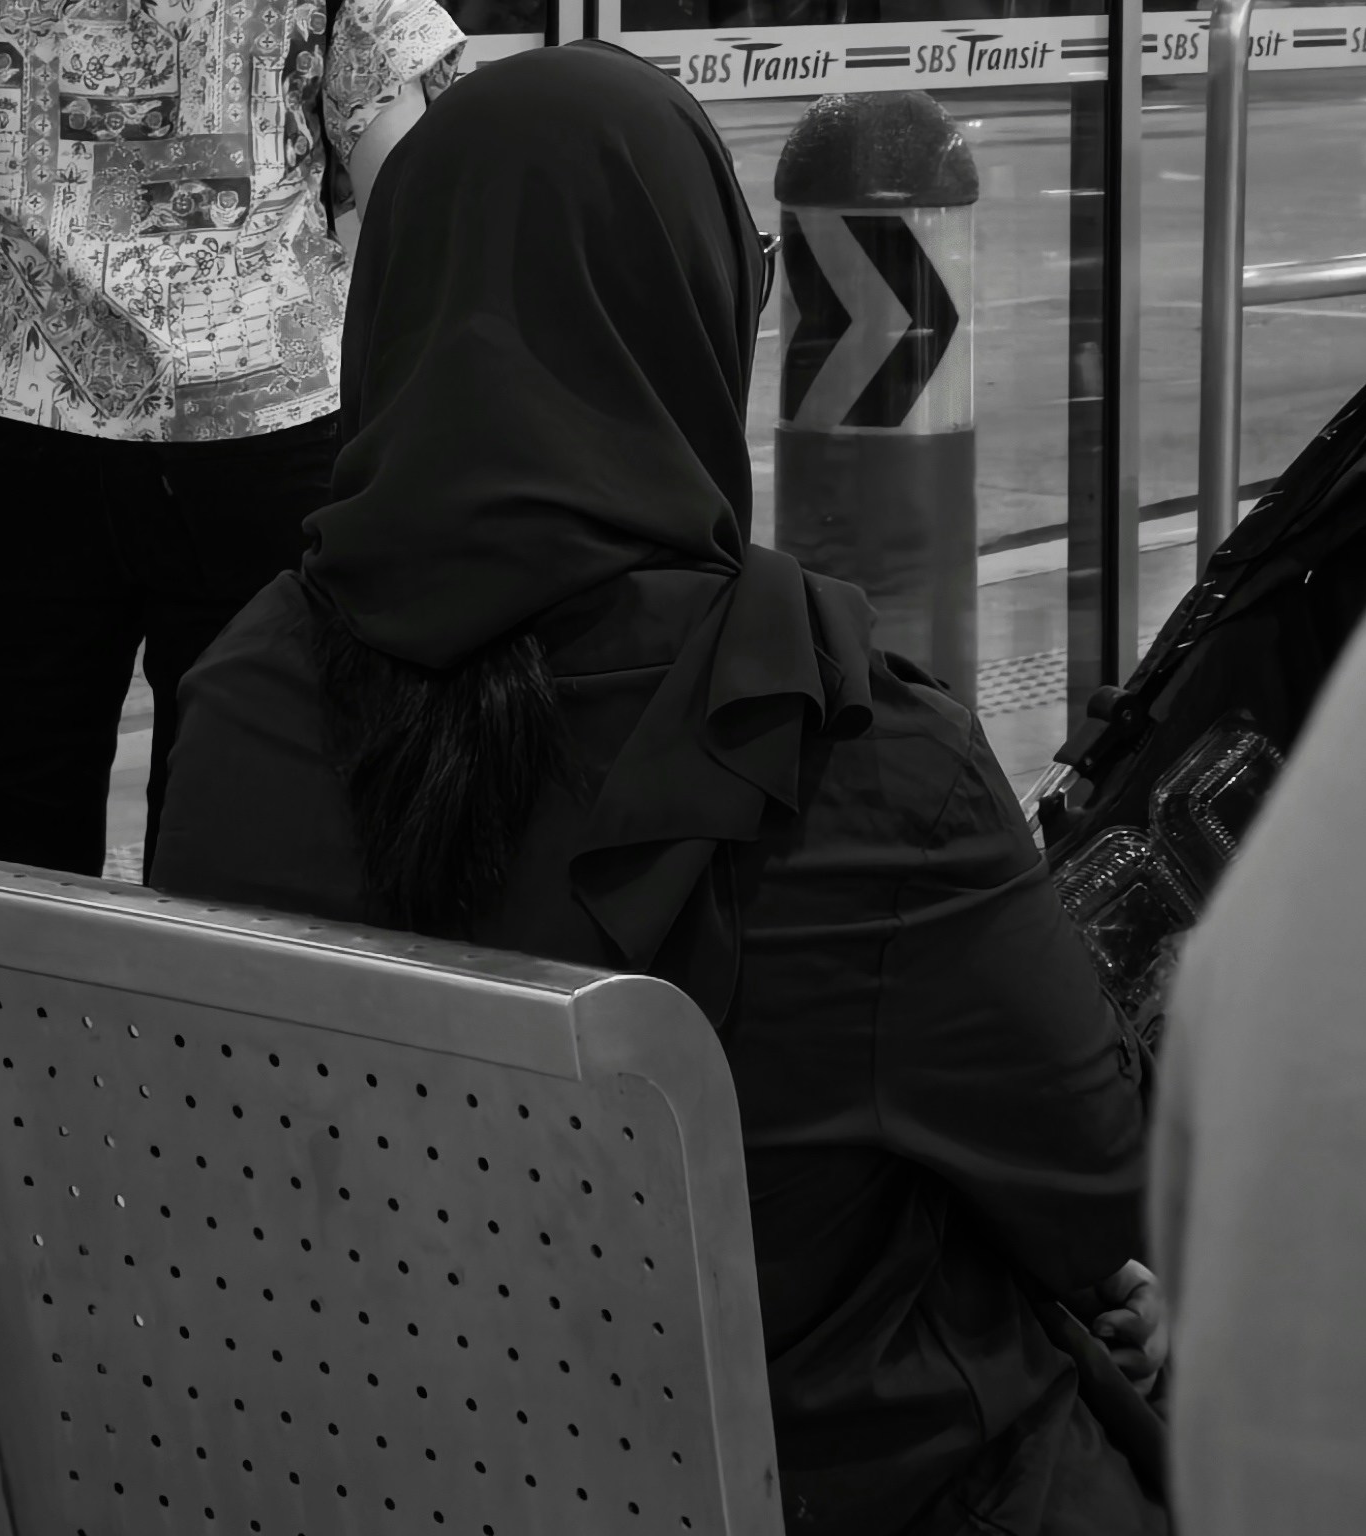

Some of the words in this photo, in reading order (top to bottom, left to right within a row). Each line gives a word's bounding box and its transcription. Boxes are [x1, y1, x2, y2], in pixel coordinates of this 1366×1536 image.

[684, 52, 732, 86] SBS
[730, 42, 840, 88] Transit
[913, 43, 958, 75] SBS
[955, 33, 1057, 77] Transit
[1161, 31, 1201, 61] SBS
